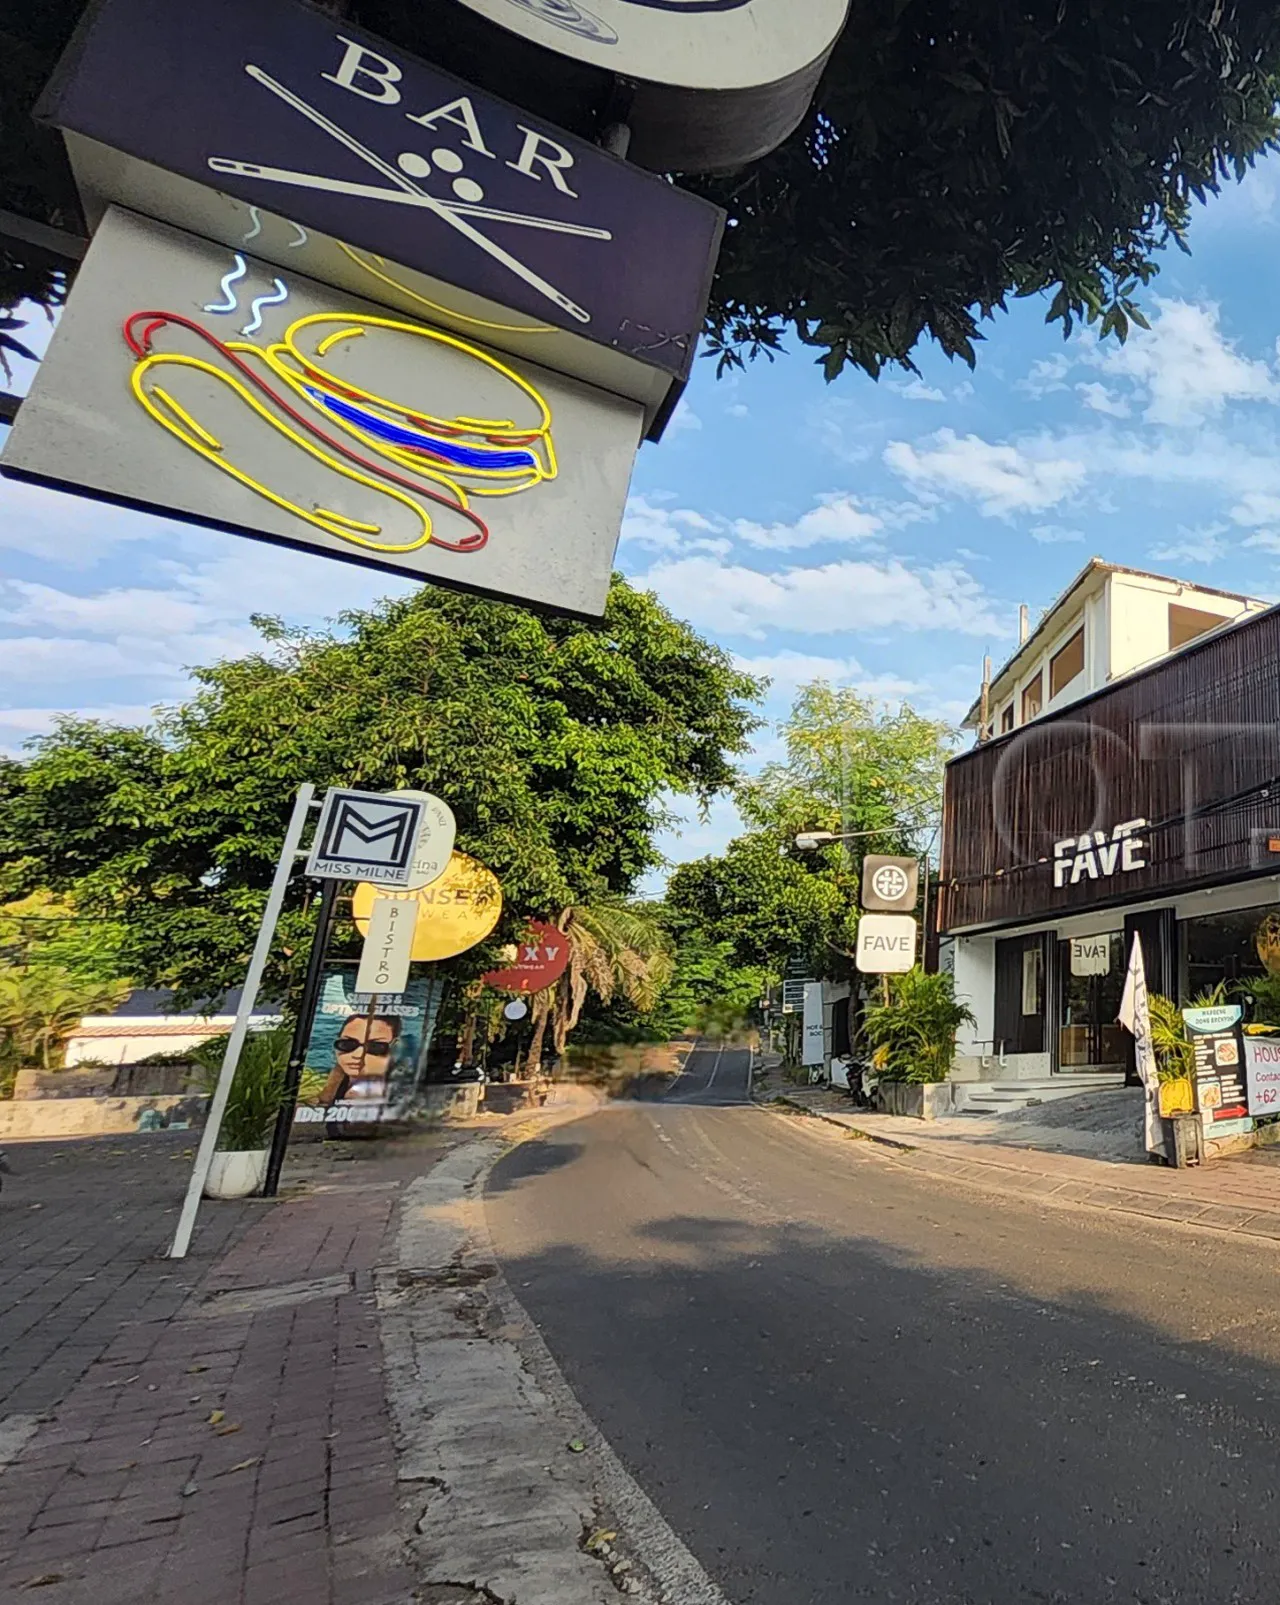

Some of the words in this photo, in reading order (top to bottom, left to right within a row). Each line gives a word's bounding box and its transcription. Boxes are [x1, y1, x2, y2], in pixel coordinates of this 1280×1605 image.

[321, 34, 578, 199] BAR
[1054, 818, 1147, 888] FAVE
[314, 862, 352, 875] MISS
[356, 866, 406, 880] MILNE
[377, 887, 480, 906] SUNSE
[374, 907, 399, 985] BISTRO
[863, 935, 911, 952] FAVE
[1255, 1088, 1276, 1103] +62
